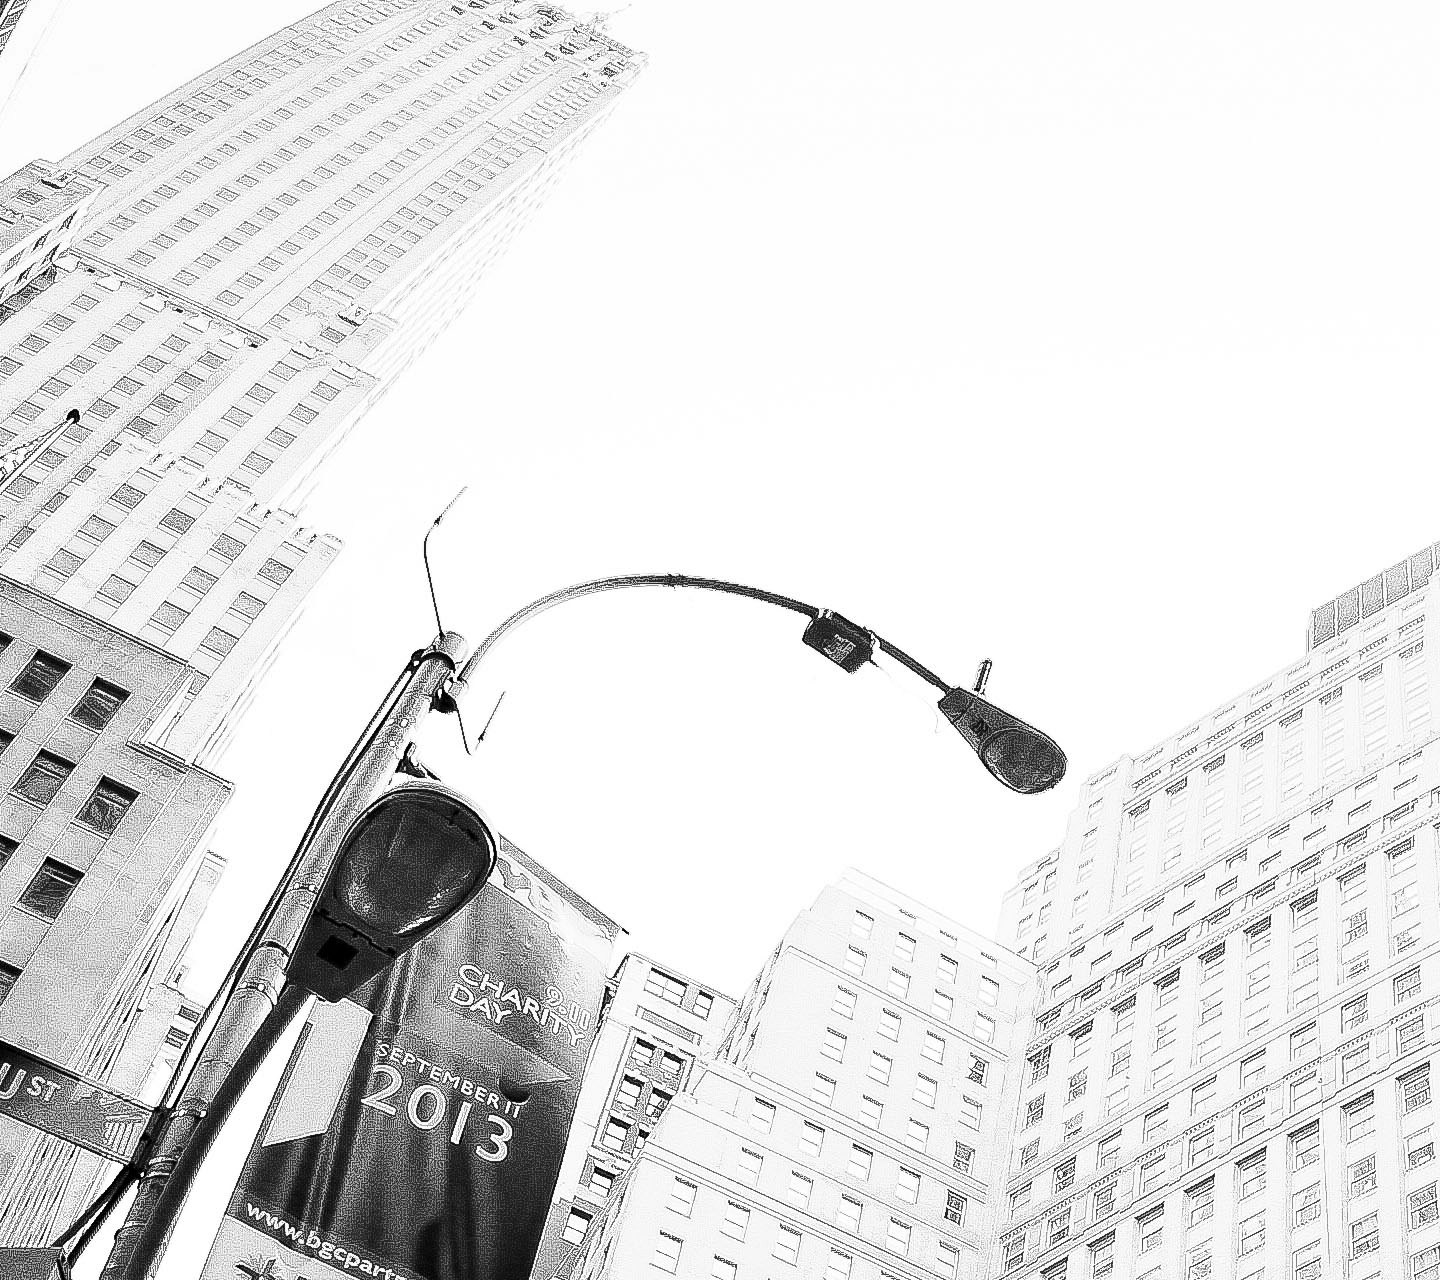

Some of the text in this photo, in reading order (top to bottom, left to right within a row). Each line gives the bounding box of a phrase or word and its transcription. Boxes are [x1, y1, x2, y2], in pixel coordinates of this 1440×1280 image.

[448, 982, 512, 1025] DAY
[458, 963, 586, 1048] CHARITY
[26, 1075, 62, 1103] ST
[377, 1042, 501, 1111] SEPTEMBER
[361, 1062, 513, 1163] 2013
